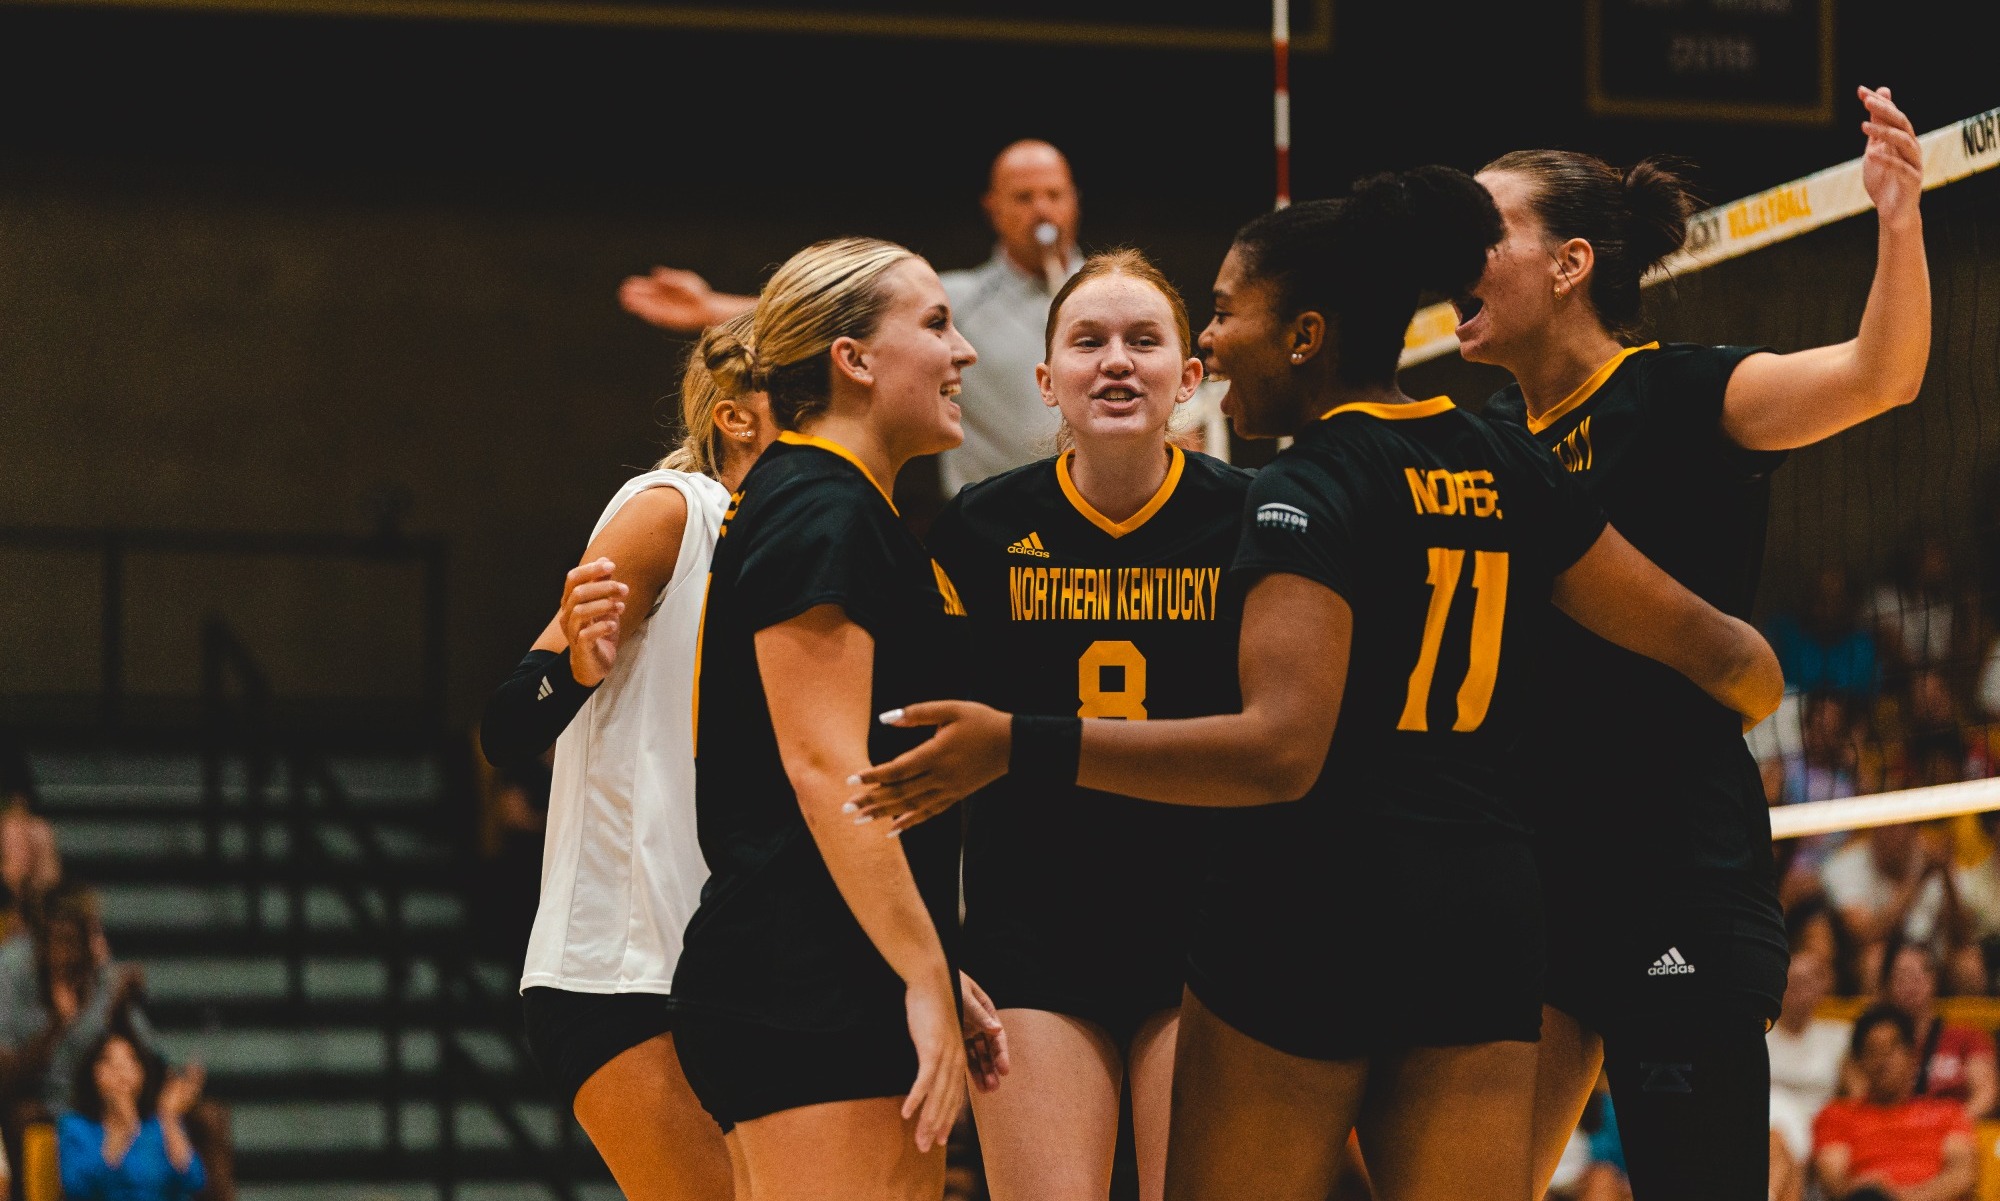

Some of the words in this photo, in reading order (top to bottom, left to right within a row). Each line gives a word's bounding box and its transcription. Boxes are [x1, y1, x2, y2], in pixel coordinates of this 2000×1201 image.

[1257, 510, 1308, 527] HORIZON
[1009, 566, 1111, 621] NORTHERN
[1116, 566, 1221, 621] KENTUCKY
[1396, 547, 1509, 732] 11
[1648, 963, 1695, 975] adidas
